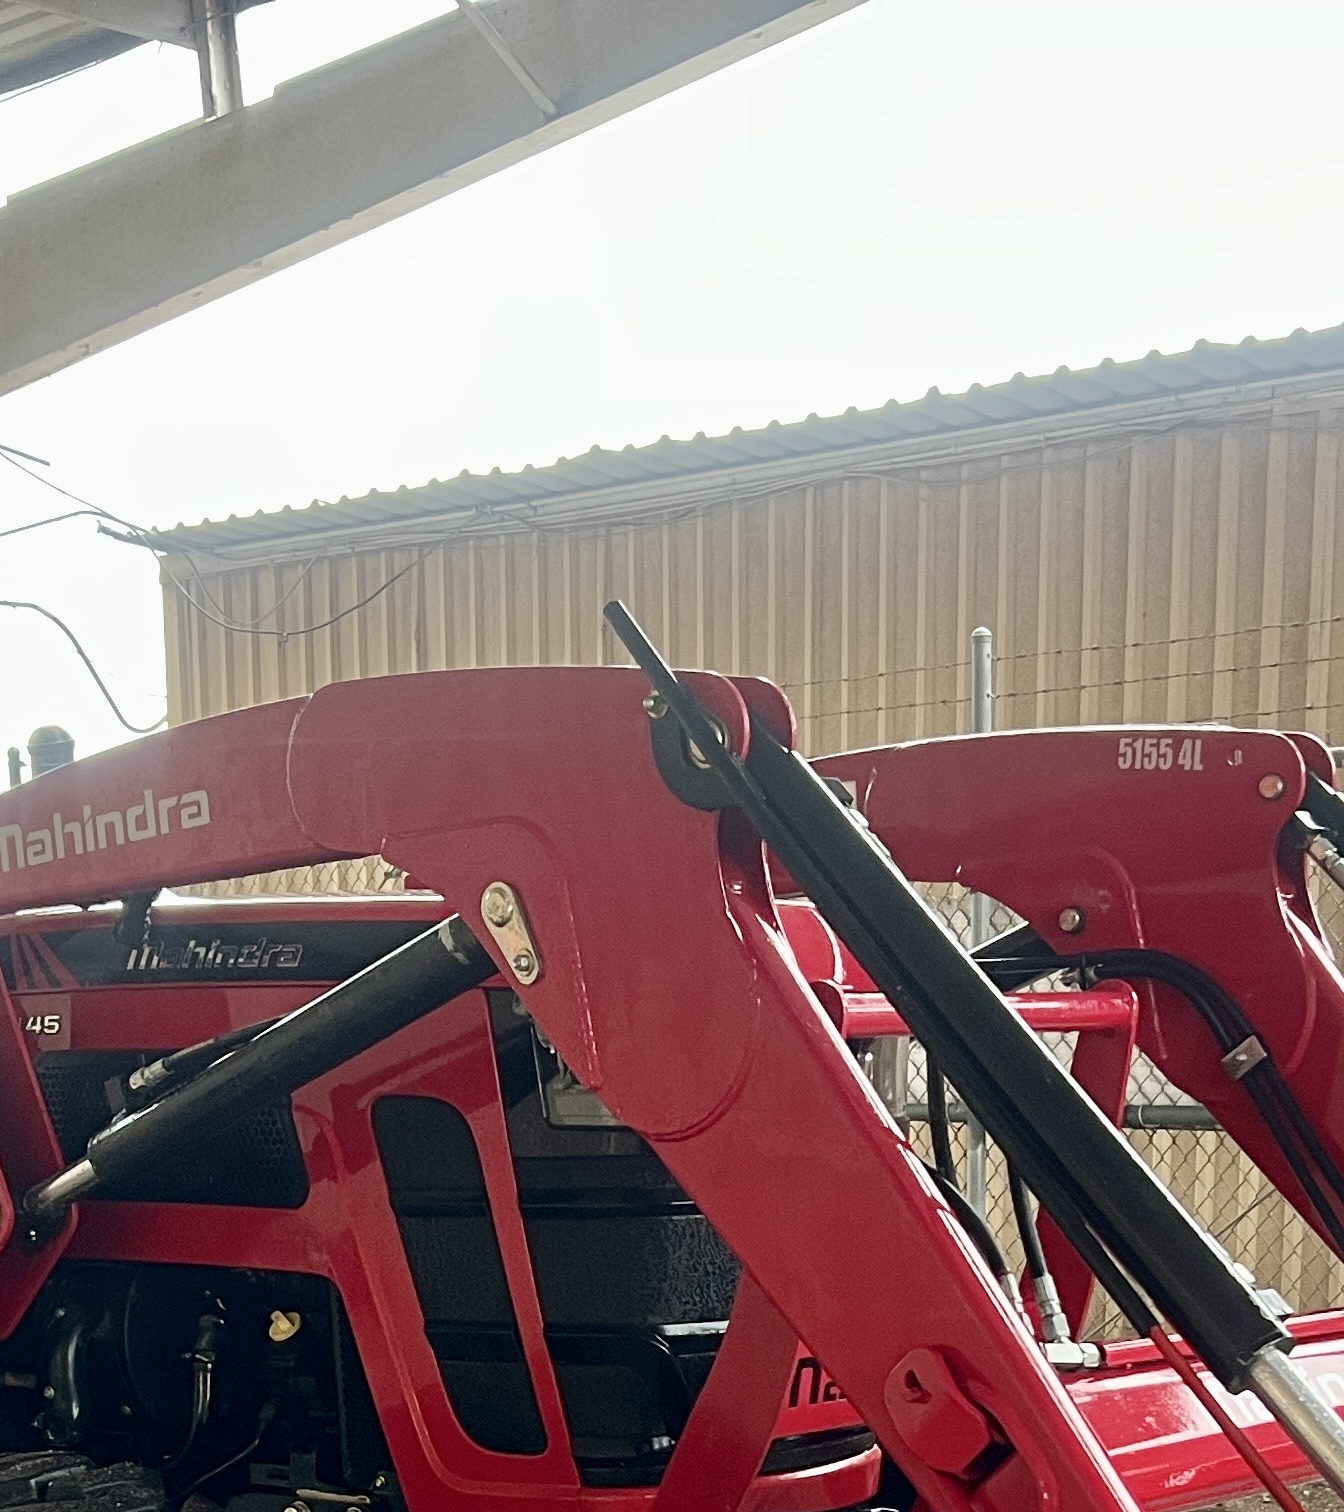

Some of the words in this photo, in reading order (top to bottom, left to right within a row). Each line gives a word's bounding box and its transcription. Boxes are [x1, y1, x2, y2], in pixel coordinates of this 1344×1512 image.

[1117, 738, 1173, 771] 5155
[1177, 738, 1203, 771] 4L
[126, 936, 304, 971] Mahindra
[20, 1014, 69, 1048] 45
